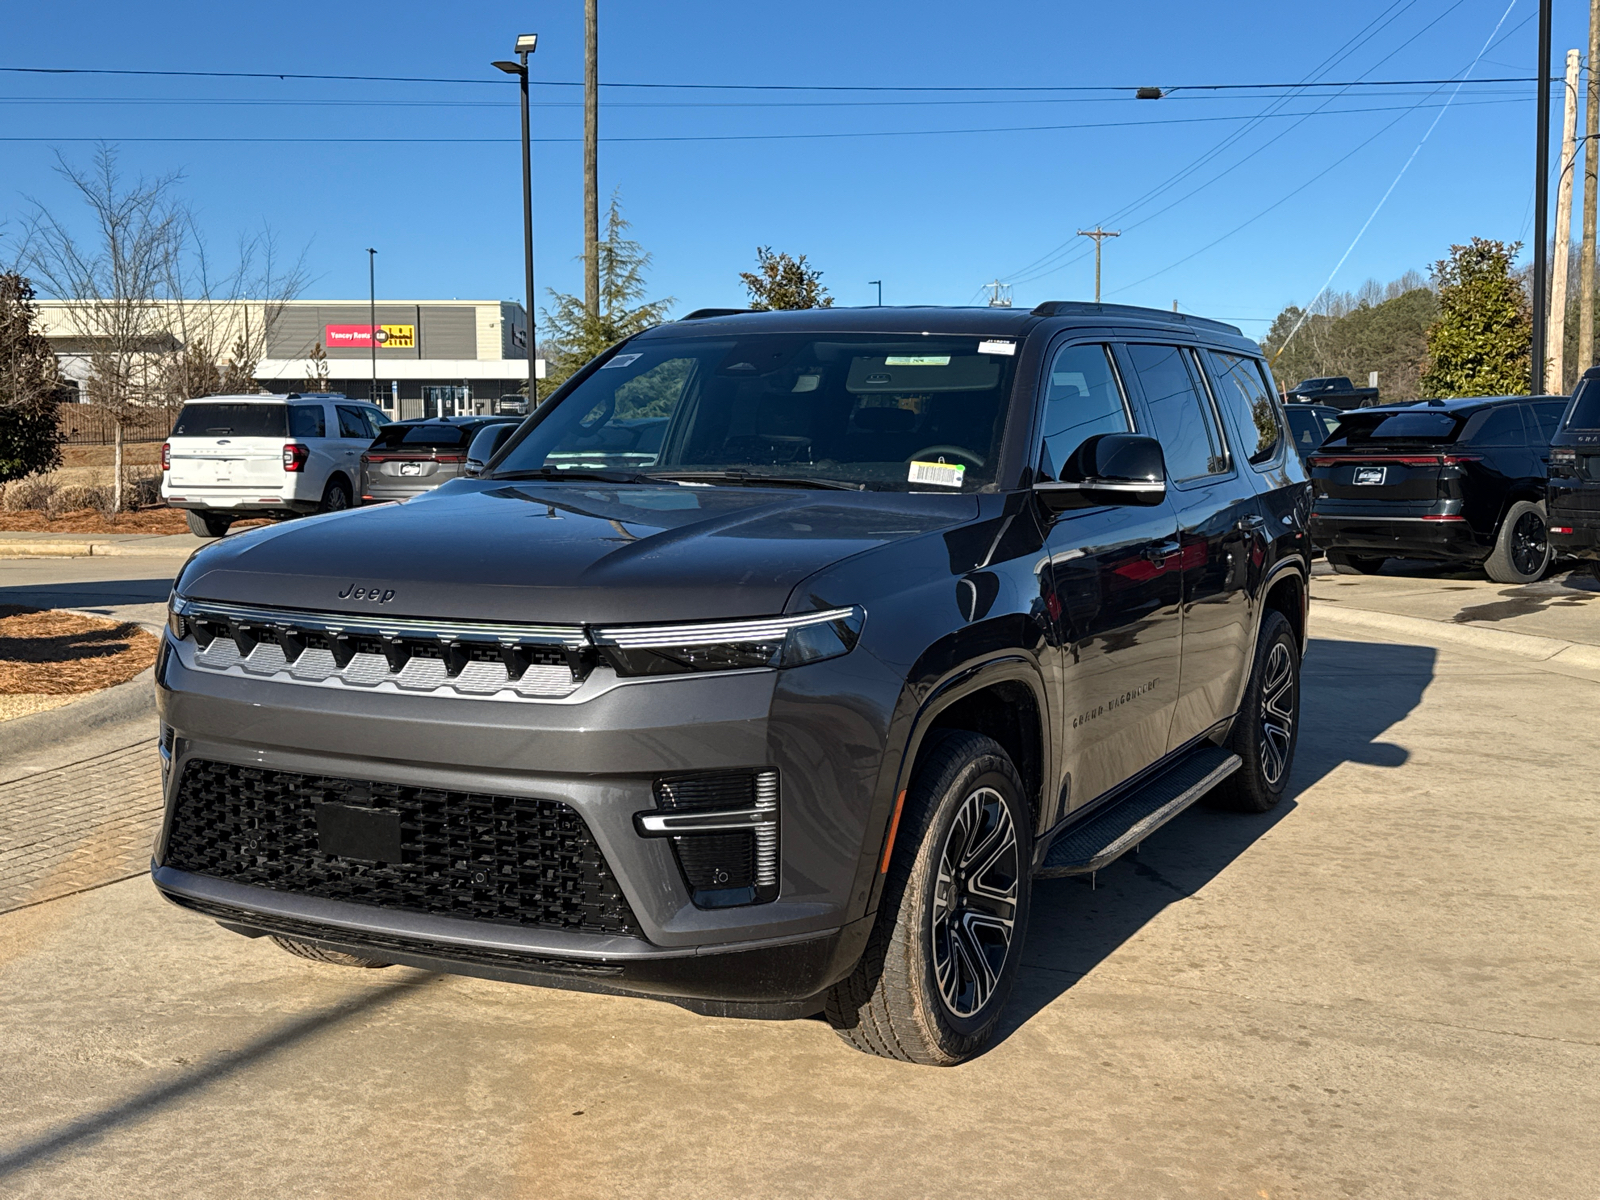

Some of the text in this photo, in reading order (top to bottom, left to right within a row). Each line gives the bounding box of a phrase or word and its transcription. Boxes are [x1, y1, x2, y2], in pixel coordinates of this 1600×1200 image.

[330, 331, 353, 341] Yancey
[338, 583, 396, 605] Jeep
[1072, 705, 1104, 729] GRAND
